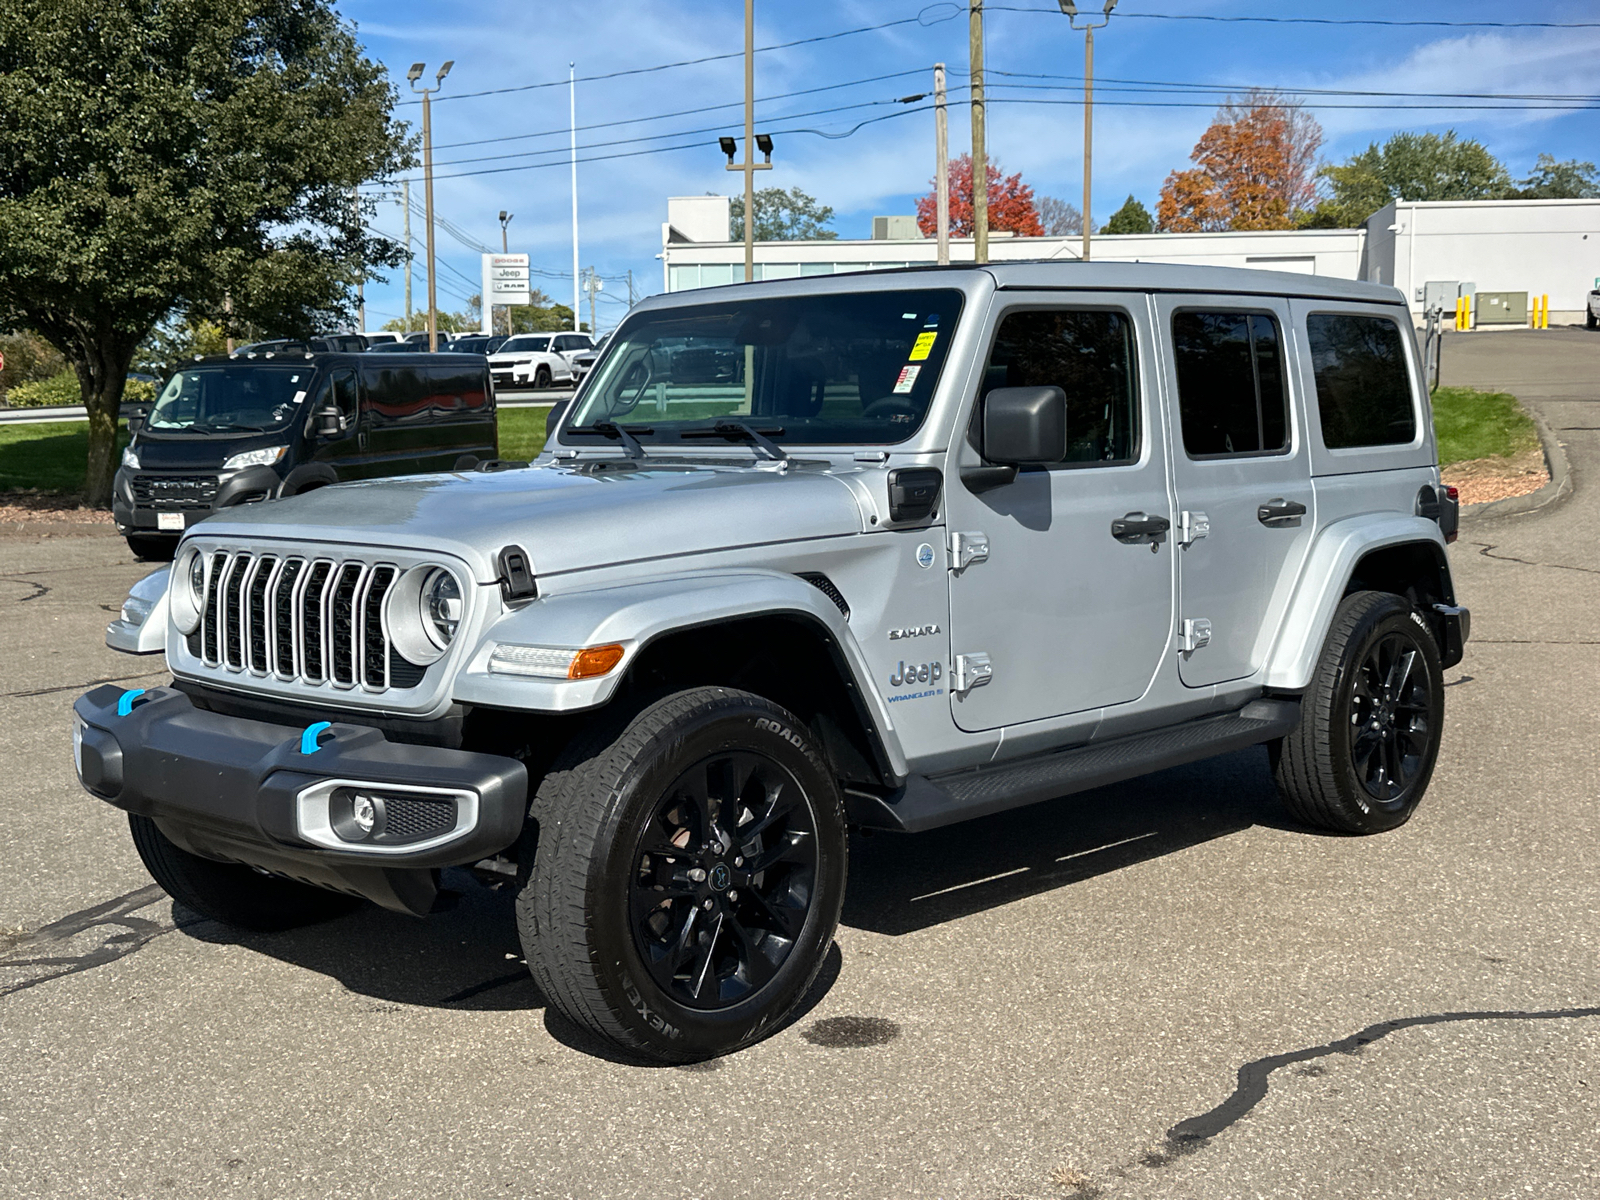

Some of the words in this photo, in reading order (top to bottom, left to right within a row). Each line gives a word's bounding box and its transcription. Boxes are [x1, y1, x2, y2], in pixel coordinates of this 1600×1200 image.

[499, 268, 521, 278] Jeep
[889, 625, 941, 641] SAHARA
[889, 660, 942, 687] Jeep
[887, 690, 935, 703] WRANGLER
